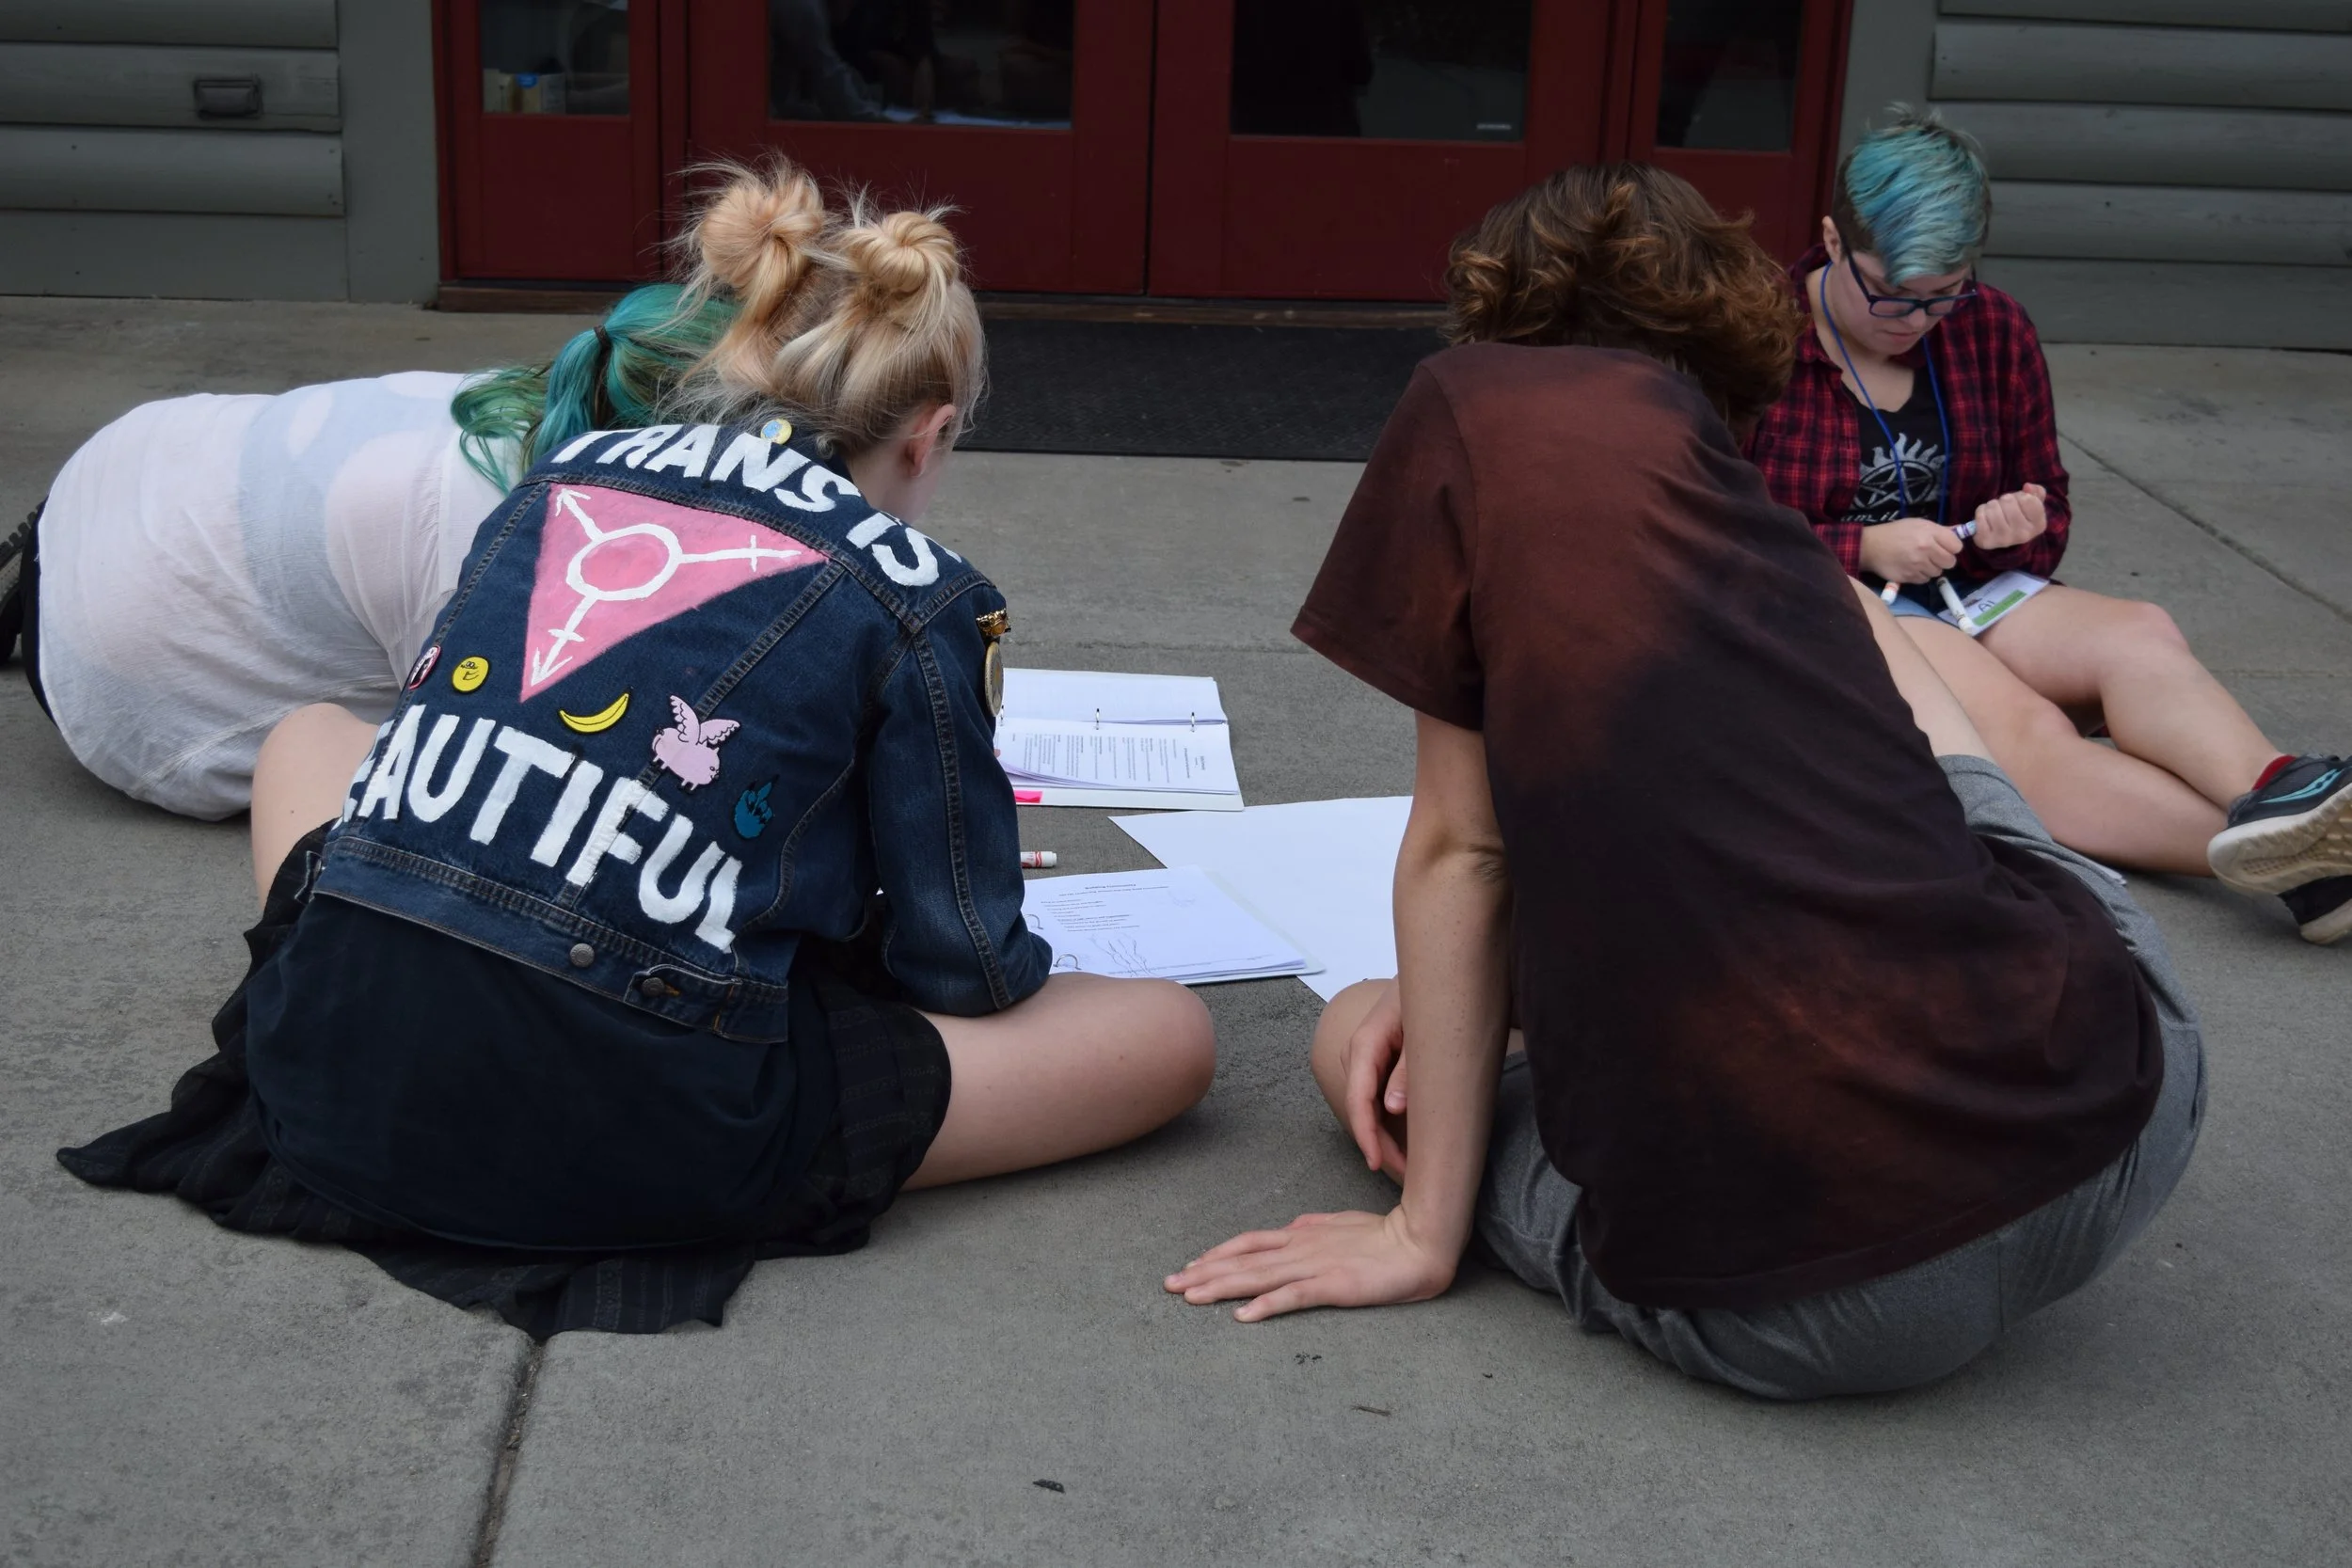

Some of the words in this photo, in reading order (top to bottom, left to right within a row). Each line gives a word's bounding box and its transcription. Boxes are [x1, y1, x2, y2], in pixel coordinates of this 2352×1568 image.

[550, 424, 861, 514] TRANS
[846, 511, 962, 587] IS
[331, 704, 743, 954] EAUTIFUL
